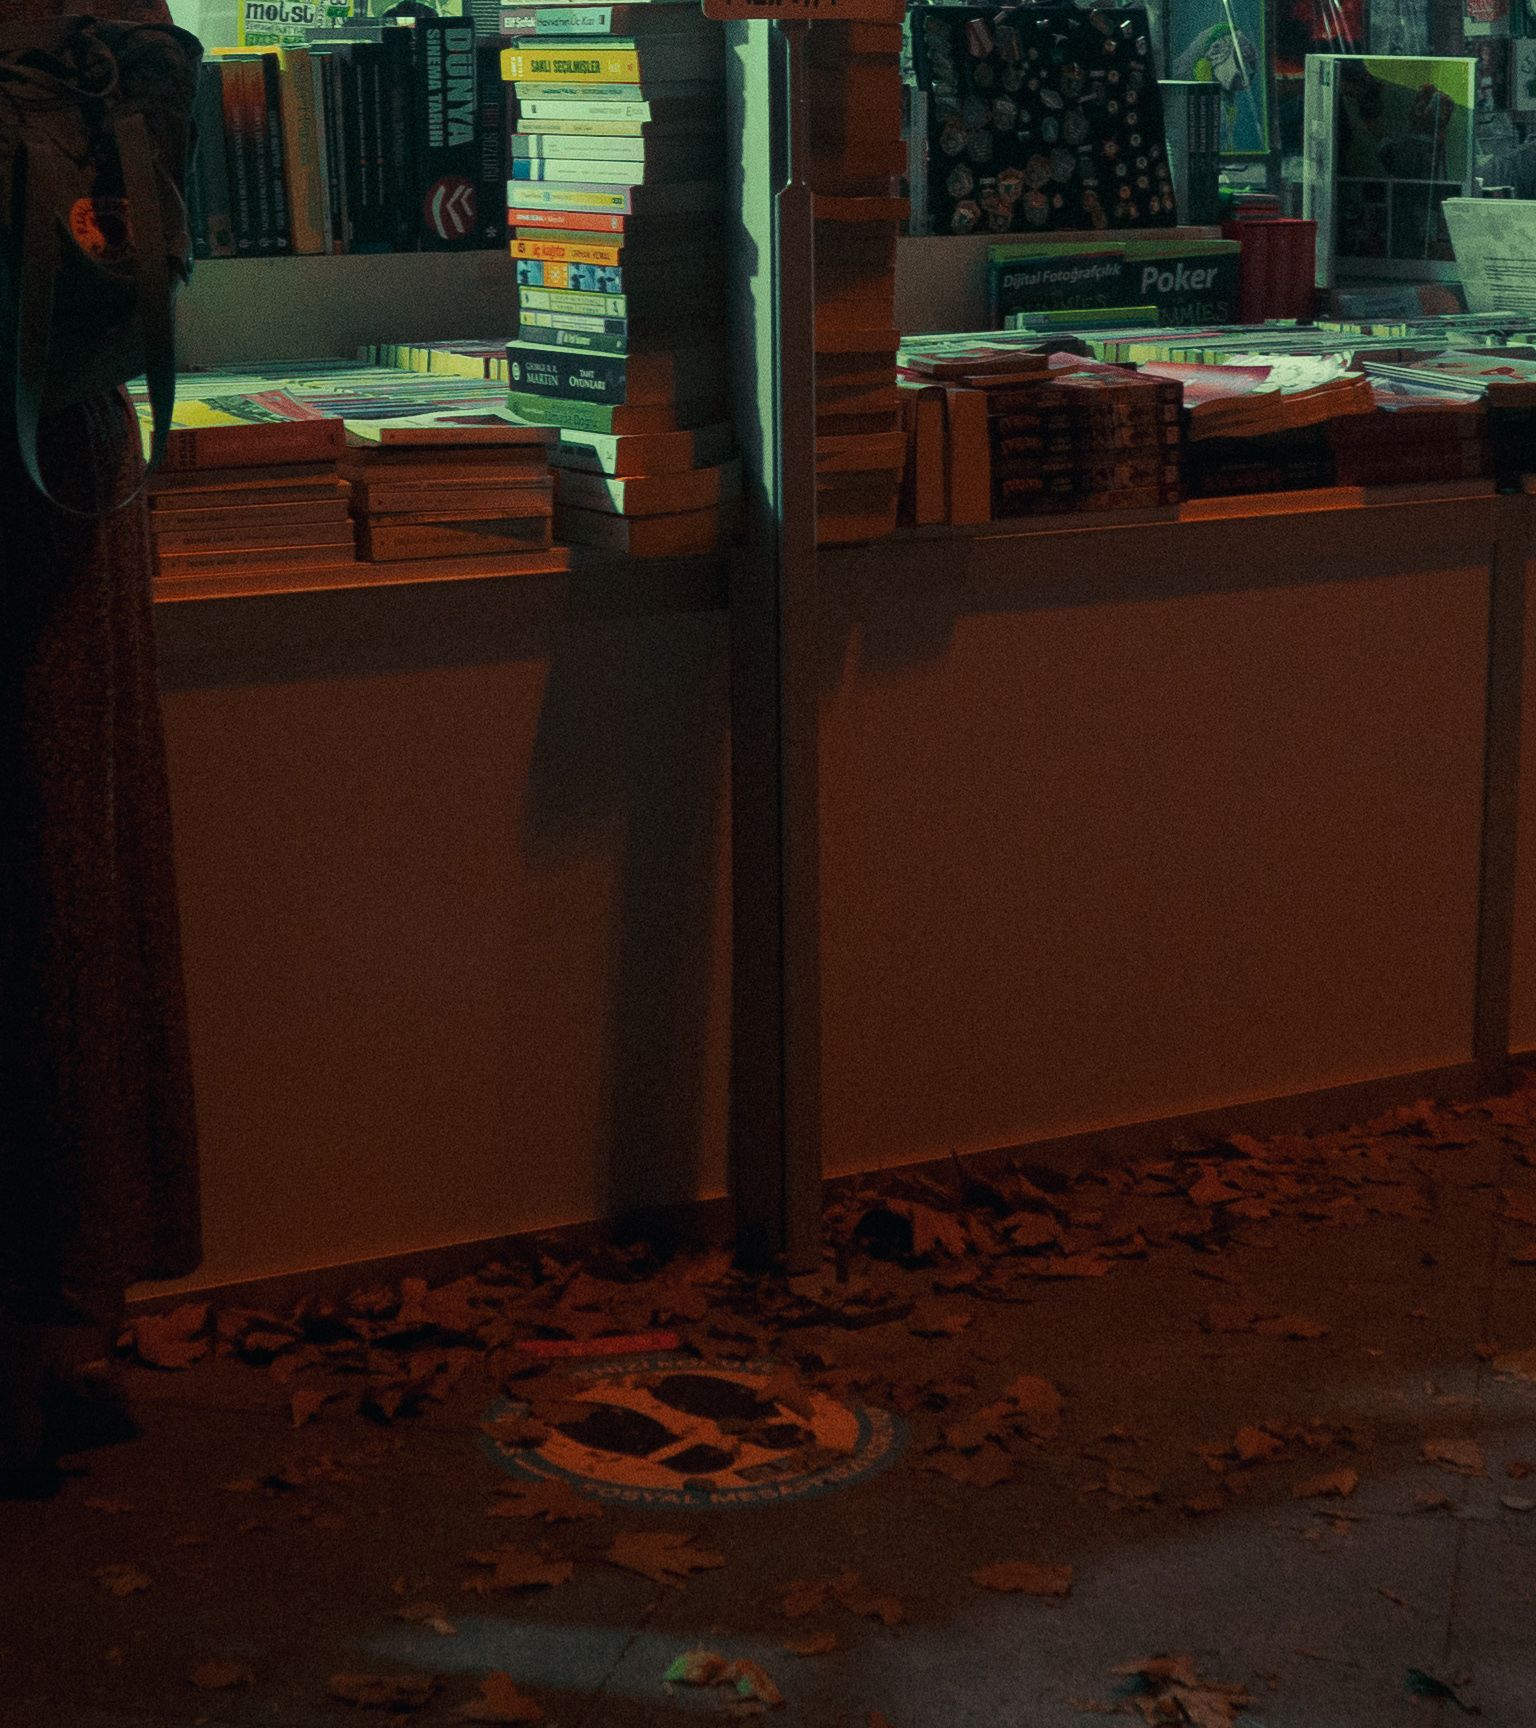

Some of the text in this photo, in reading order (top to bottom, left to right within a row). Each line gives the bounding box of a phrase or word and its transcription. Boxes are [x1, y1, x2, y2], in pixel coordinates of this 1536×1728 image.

[444, 28, 475, 148] DÜNYA
[1003, 272, 1041, 289] Dijital
[1140, 263, 1219, 293] Poker
